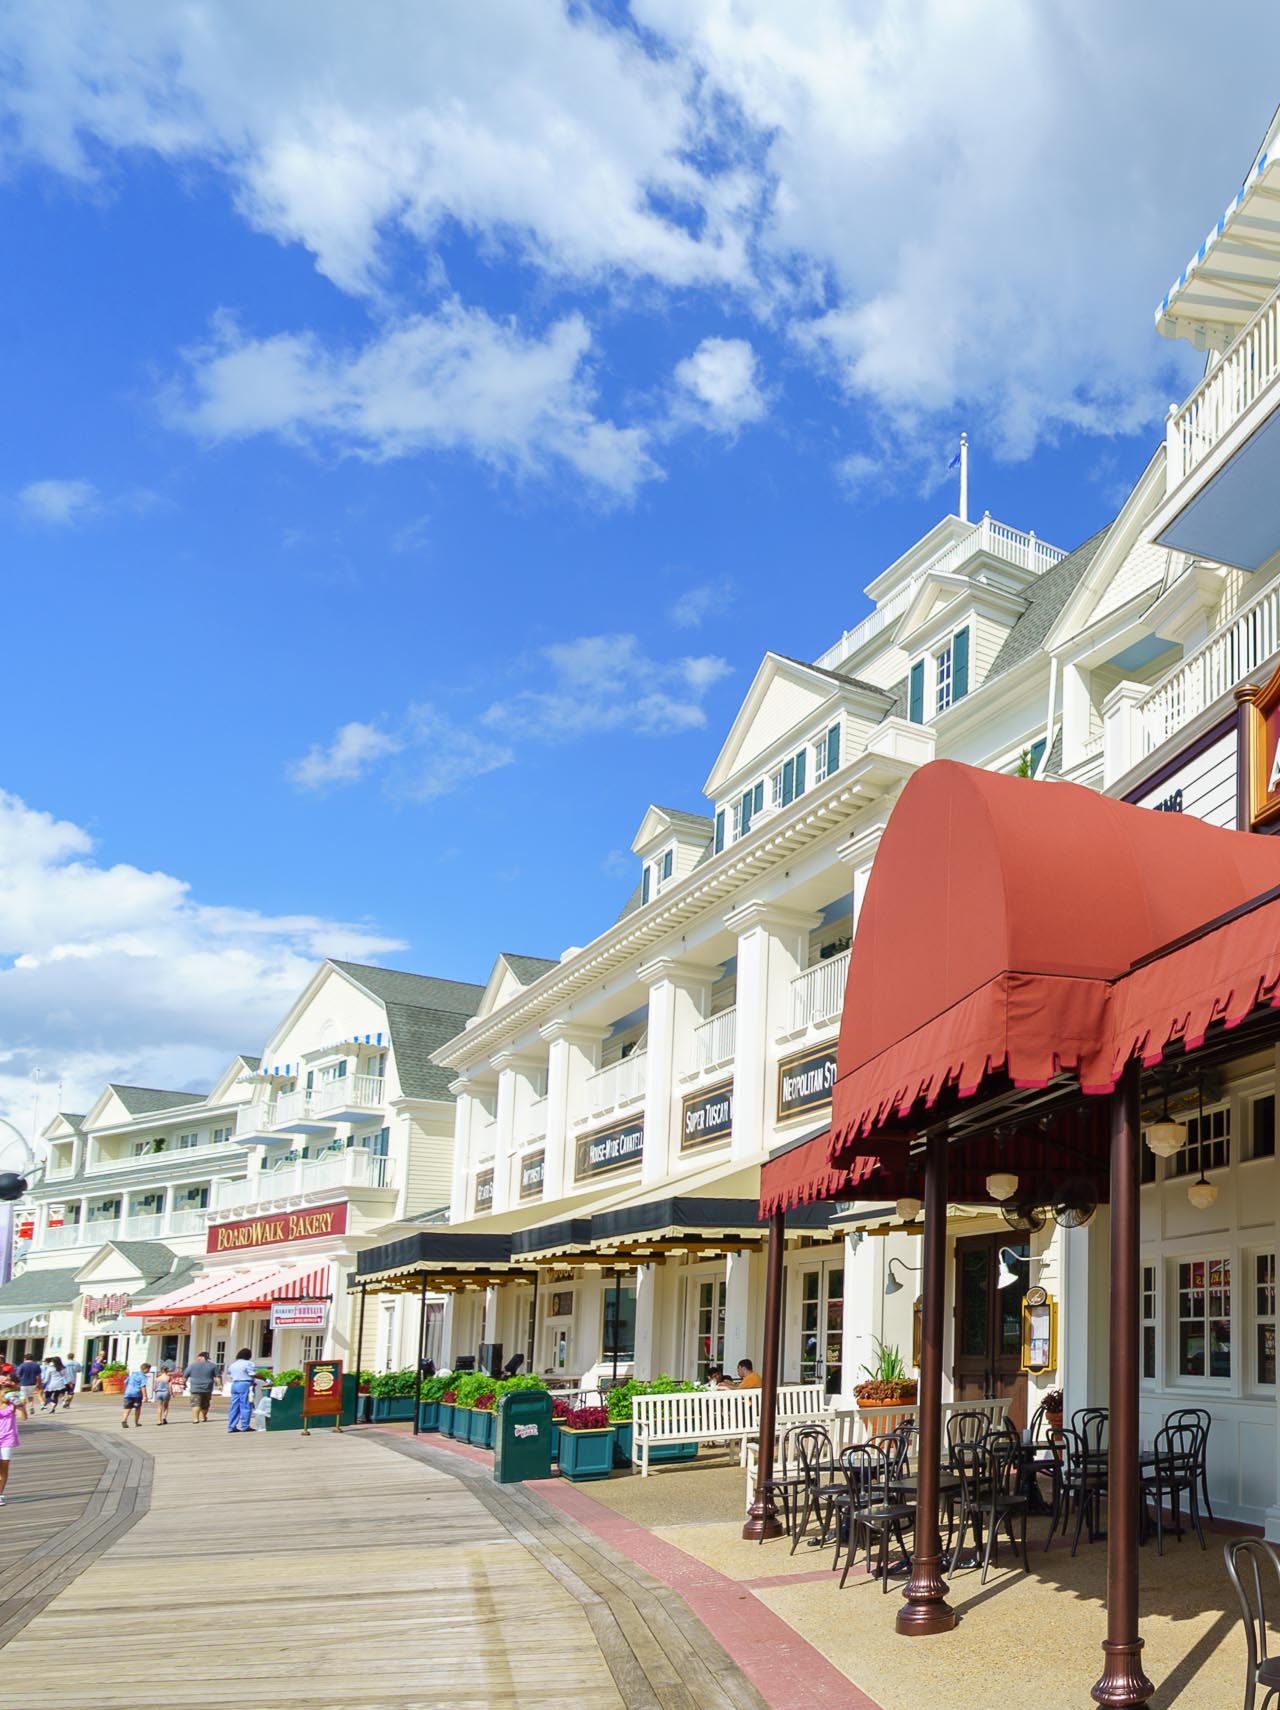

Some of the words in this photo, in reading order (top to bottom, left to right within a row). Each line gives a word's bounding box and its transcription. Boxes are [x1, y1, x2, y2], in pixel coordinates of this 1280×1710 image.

[782, 1067, 824, 1103] NEOPOLITAN
[686, 1109, 705, 1134] SUPER
[705, 1101, 729, 1127] TUSCAN
[288, 1212, 334, 1240] BAKERY
